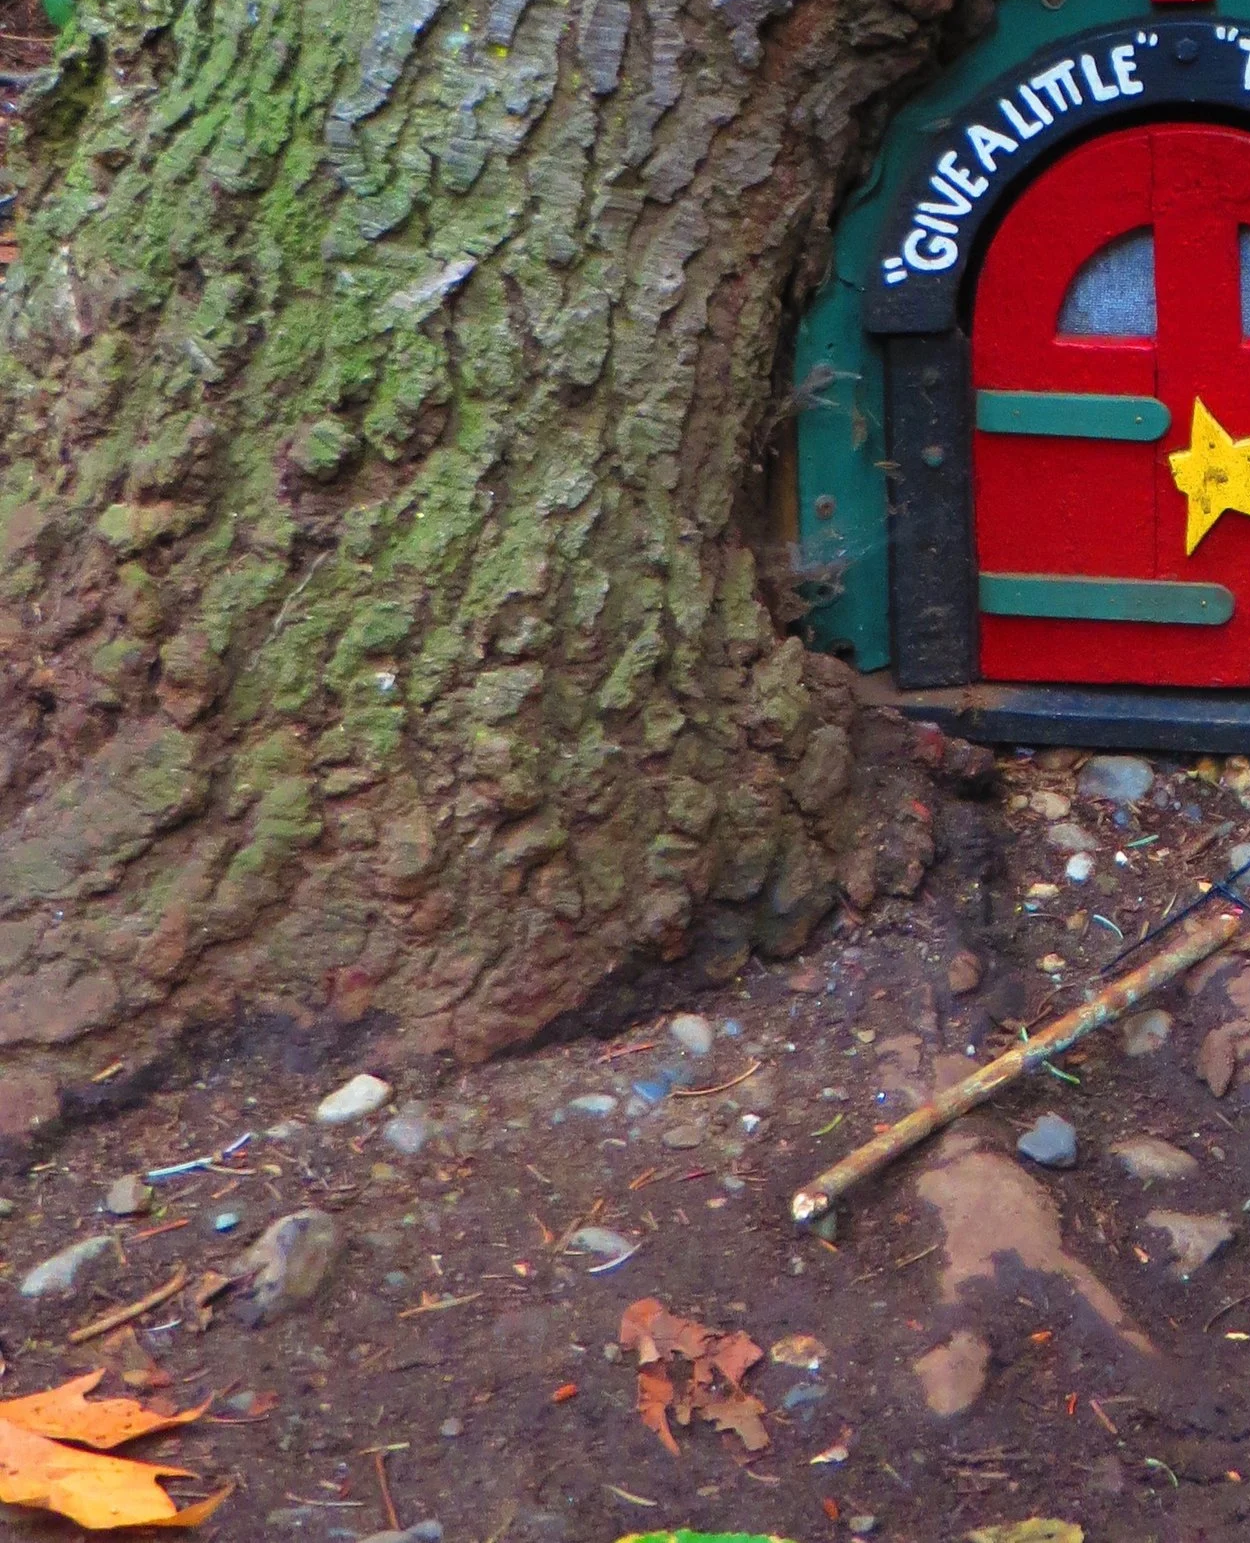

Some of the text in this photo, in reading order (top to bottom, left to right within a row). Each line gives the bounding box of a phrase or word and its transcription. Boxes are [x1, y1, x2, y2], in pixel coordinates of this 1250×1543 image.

[882, 30, 1159, 285] "GIVE A LITTLE"
